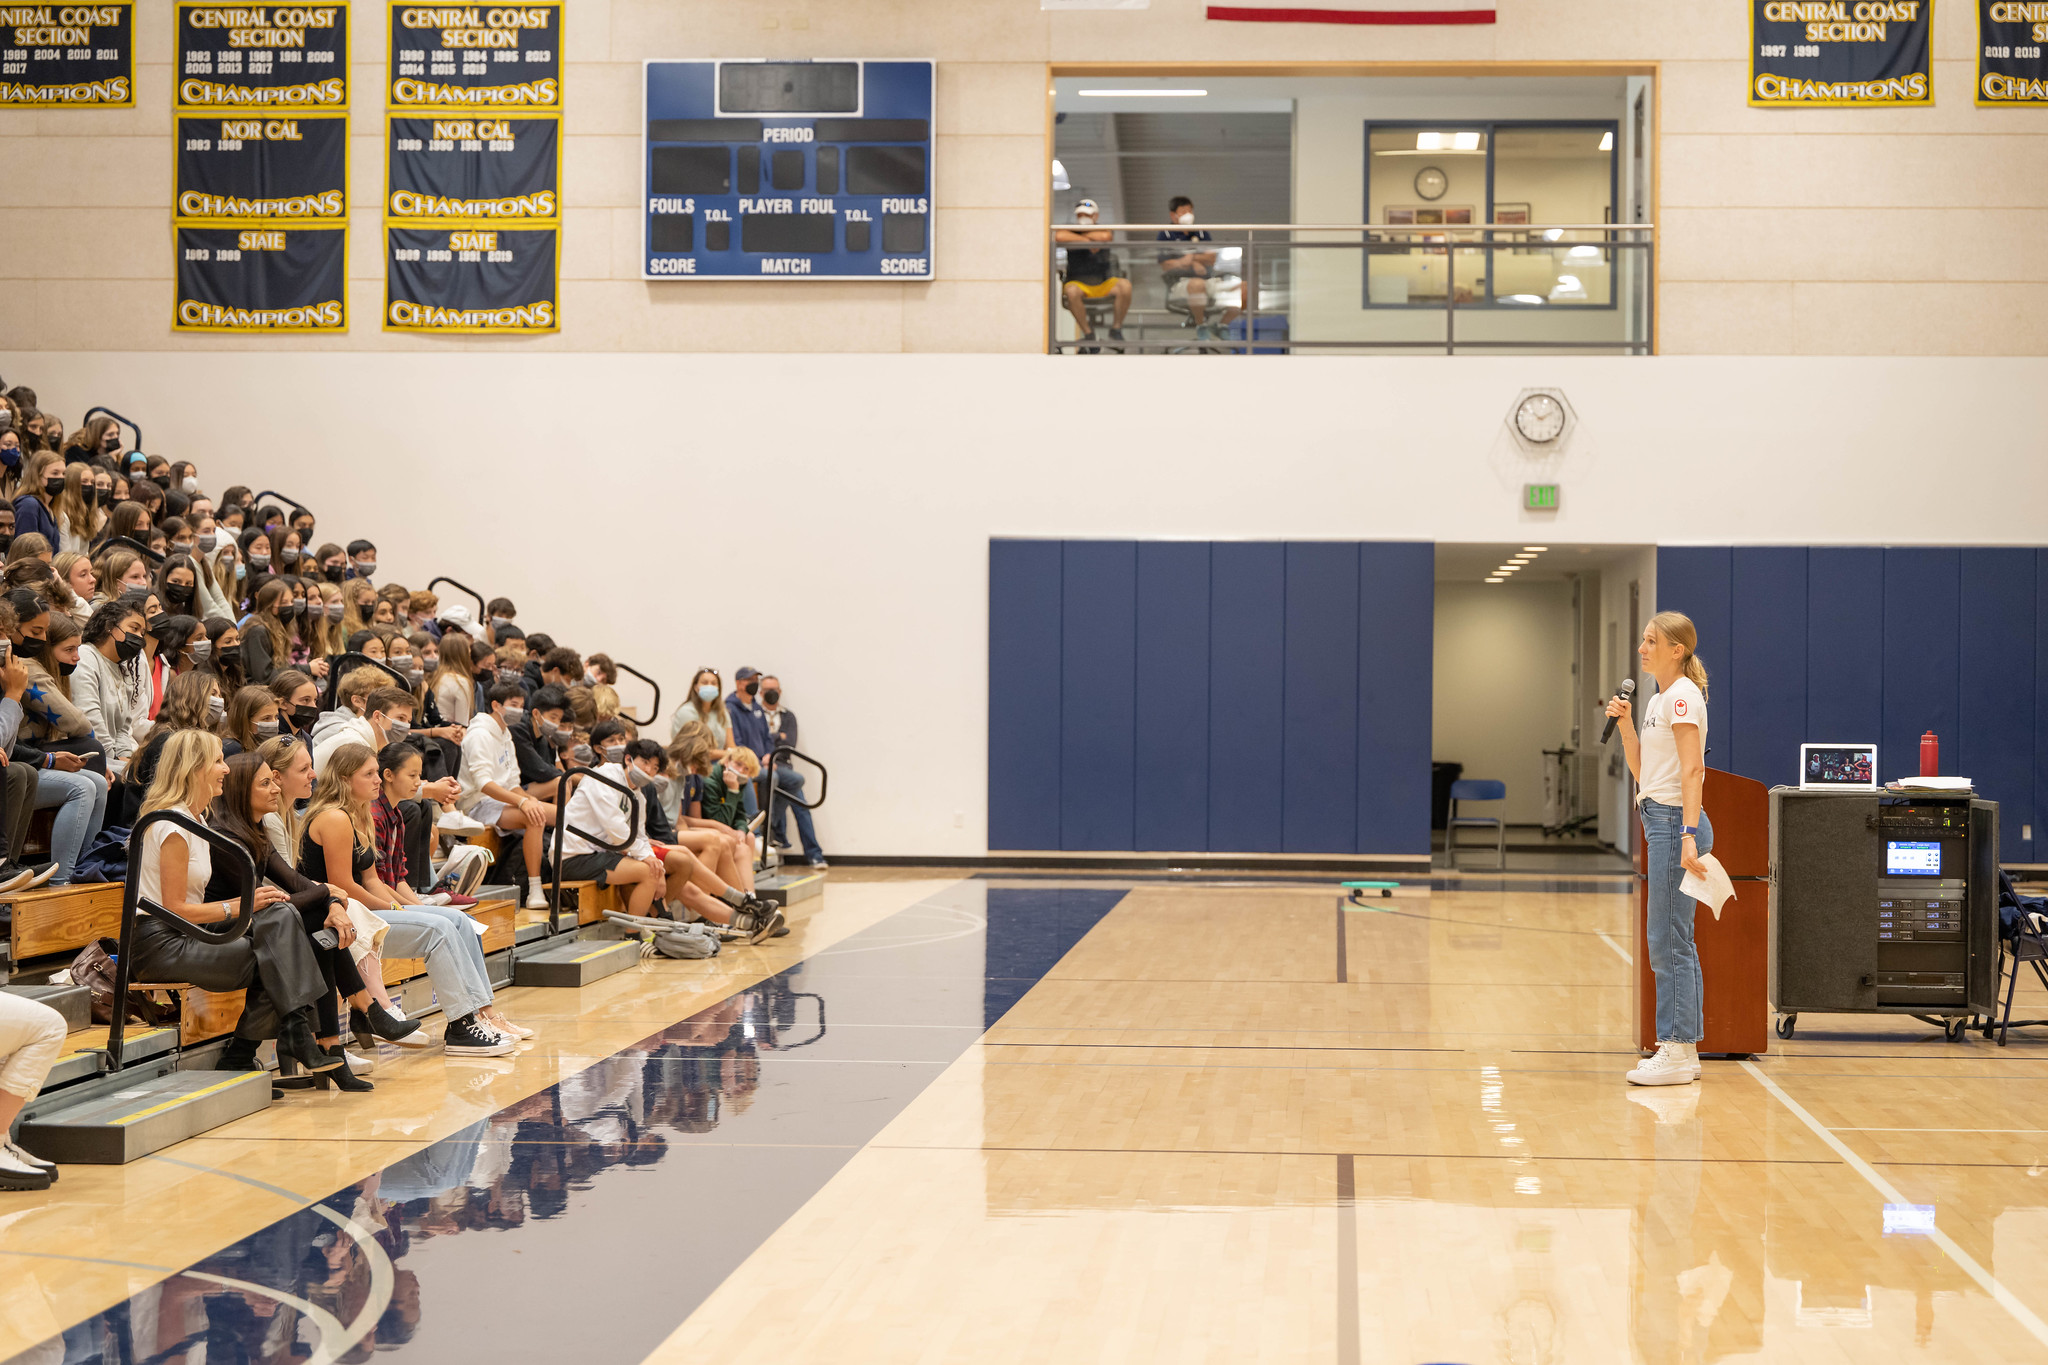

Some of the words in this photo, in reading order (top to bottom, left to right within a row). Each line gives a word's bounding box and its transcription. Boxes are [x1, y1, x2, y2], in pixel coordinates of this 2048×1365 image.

[0, 7, 56, 26] NTRAL
[60, 7, 121, 26] COAST
[190, 8, 270, 28] CENTRAL
[273, 8, 337, 28] COAST
[401, 8, 483, 28] CENTRAL
[487, 8, 550, 28] COAST
[1764, 1, 1850, 22] CENTRAL
[1854, 1, 1919, 22] COAST
[15, 27, 90, 45] SECTION
[228, 28, 304, 47] SECTION
[441, 28, 518, 48] SECTION
[1806, 22, 1886, 41] SECTION
[34, 49, 60, 60] 2004
[67, 49, 91, 60] 2010
[96, 49, 118, 60] 2011
[1761, 45, 1787, 57] 1997
[3, 63, 27, 74] 2017
[217, 62, 242, 74] 2013
[248, 62, 273, 74] 2017
[182, 78, 344, 103] CHAMPIONS
[393, 79, 557, 104] CHAMPIONS
[1755, 74, 1927, 99] CHAMPIONS
[222, 121, 262, 140] NOR
[265, 120, 302, 140] CAL
[433, 121, 475, 139] NOR
[477, 121, 515, 139] CAL
[763, 127, 814, 143] PERIOD
[181, 191, 343, 216] CHAMPIONS
[391, 191, 555, 217] CHAMPIONS
[649, 198, 695, 214] FOULS
[739, 198, 793, 214] PLAYER
[800, 198, 837, 214] FOUL
[881, 198, 928, 214] FOULS
[239, 231, 286, 250] STATE
[449, 232, 497, 251] STATE
[650, 258, 696, 274] SCORE
[761, 258, 811, 274] MATCH
[880, 258, 927, 274] SCORE
[180, 300, 342, 326] CHAMPIONS
[389, 301, 553, 327] CHAMPIONS
[1529, 486, 1556, 507] EXIT
